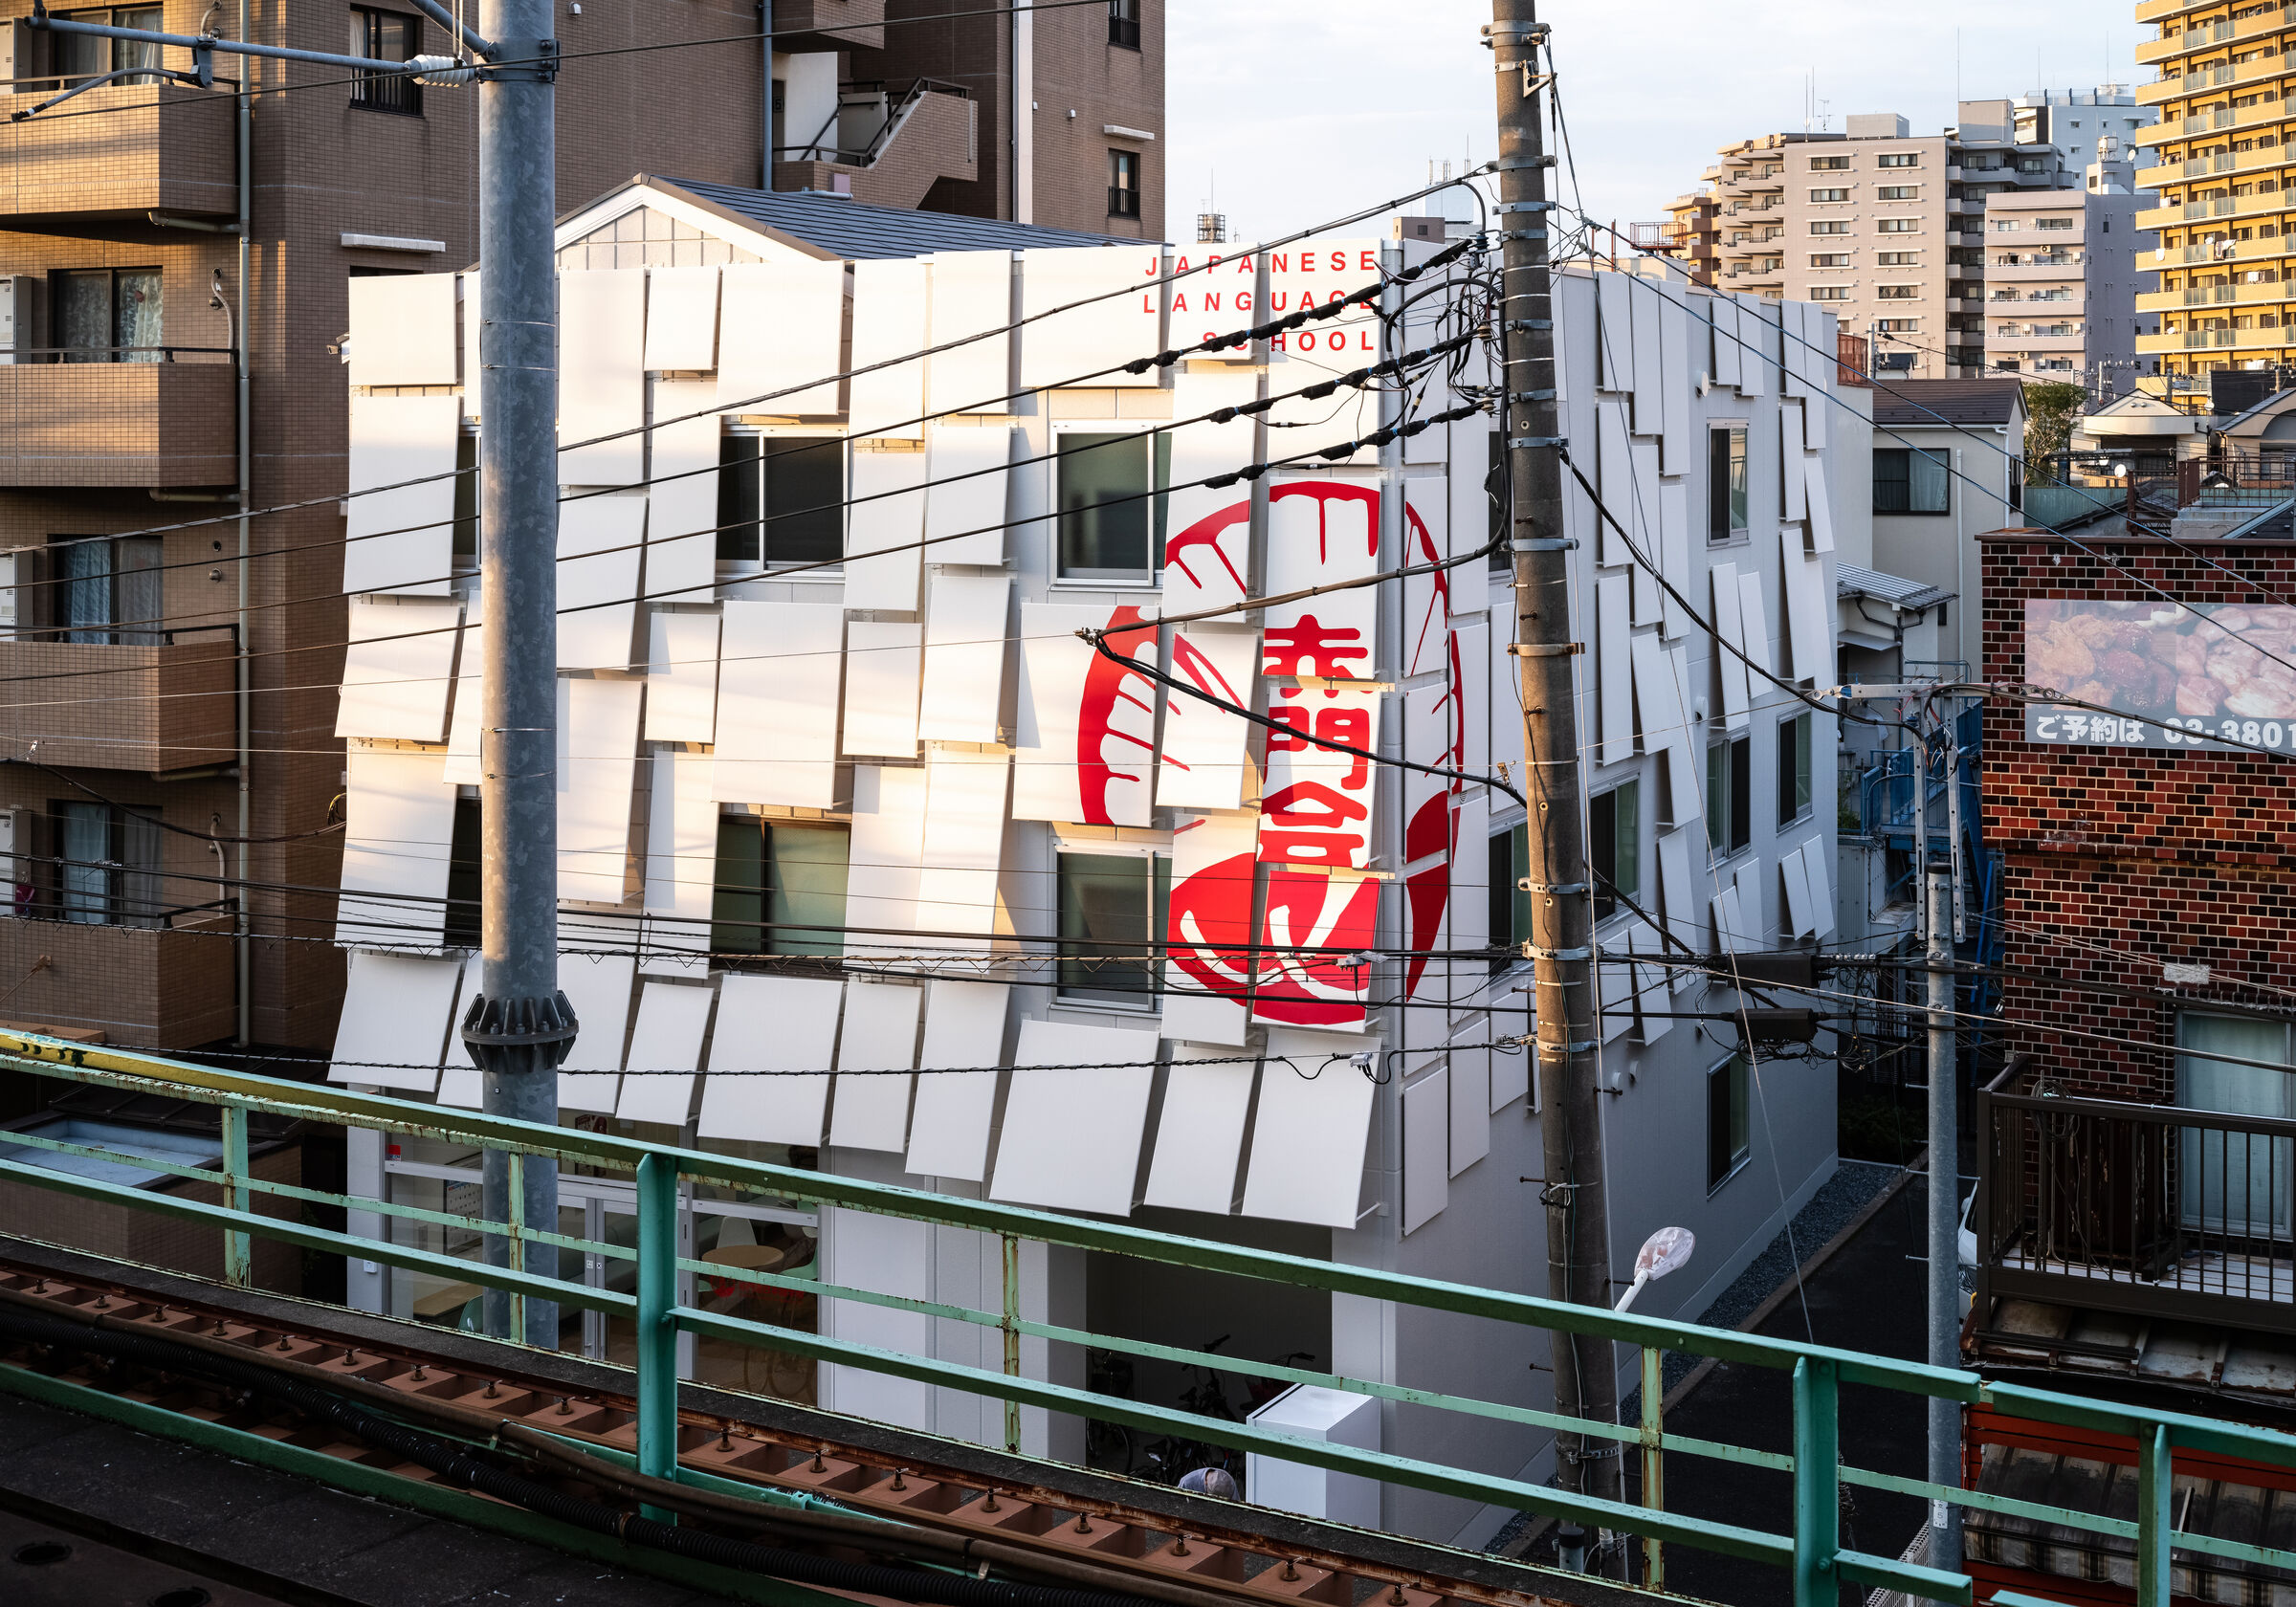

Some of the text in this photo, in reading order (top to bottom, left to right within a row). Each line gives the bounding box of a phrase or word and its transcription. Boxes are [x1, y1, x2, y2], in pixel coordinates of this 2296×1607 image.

[1145, 251, 1375, 276] JAPANESE
[1203, 331, 1374, 352] HOOL
[2036, 714, 2145, 743] ご予約は
